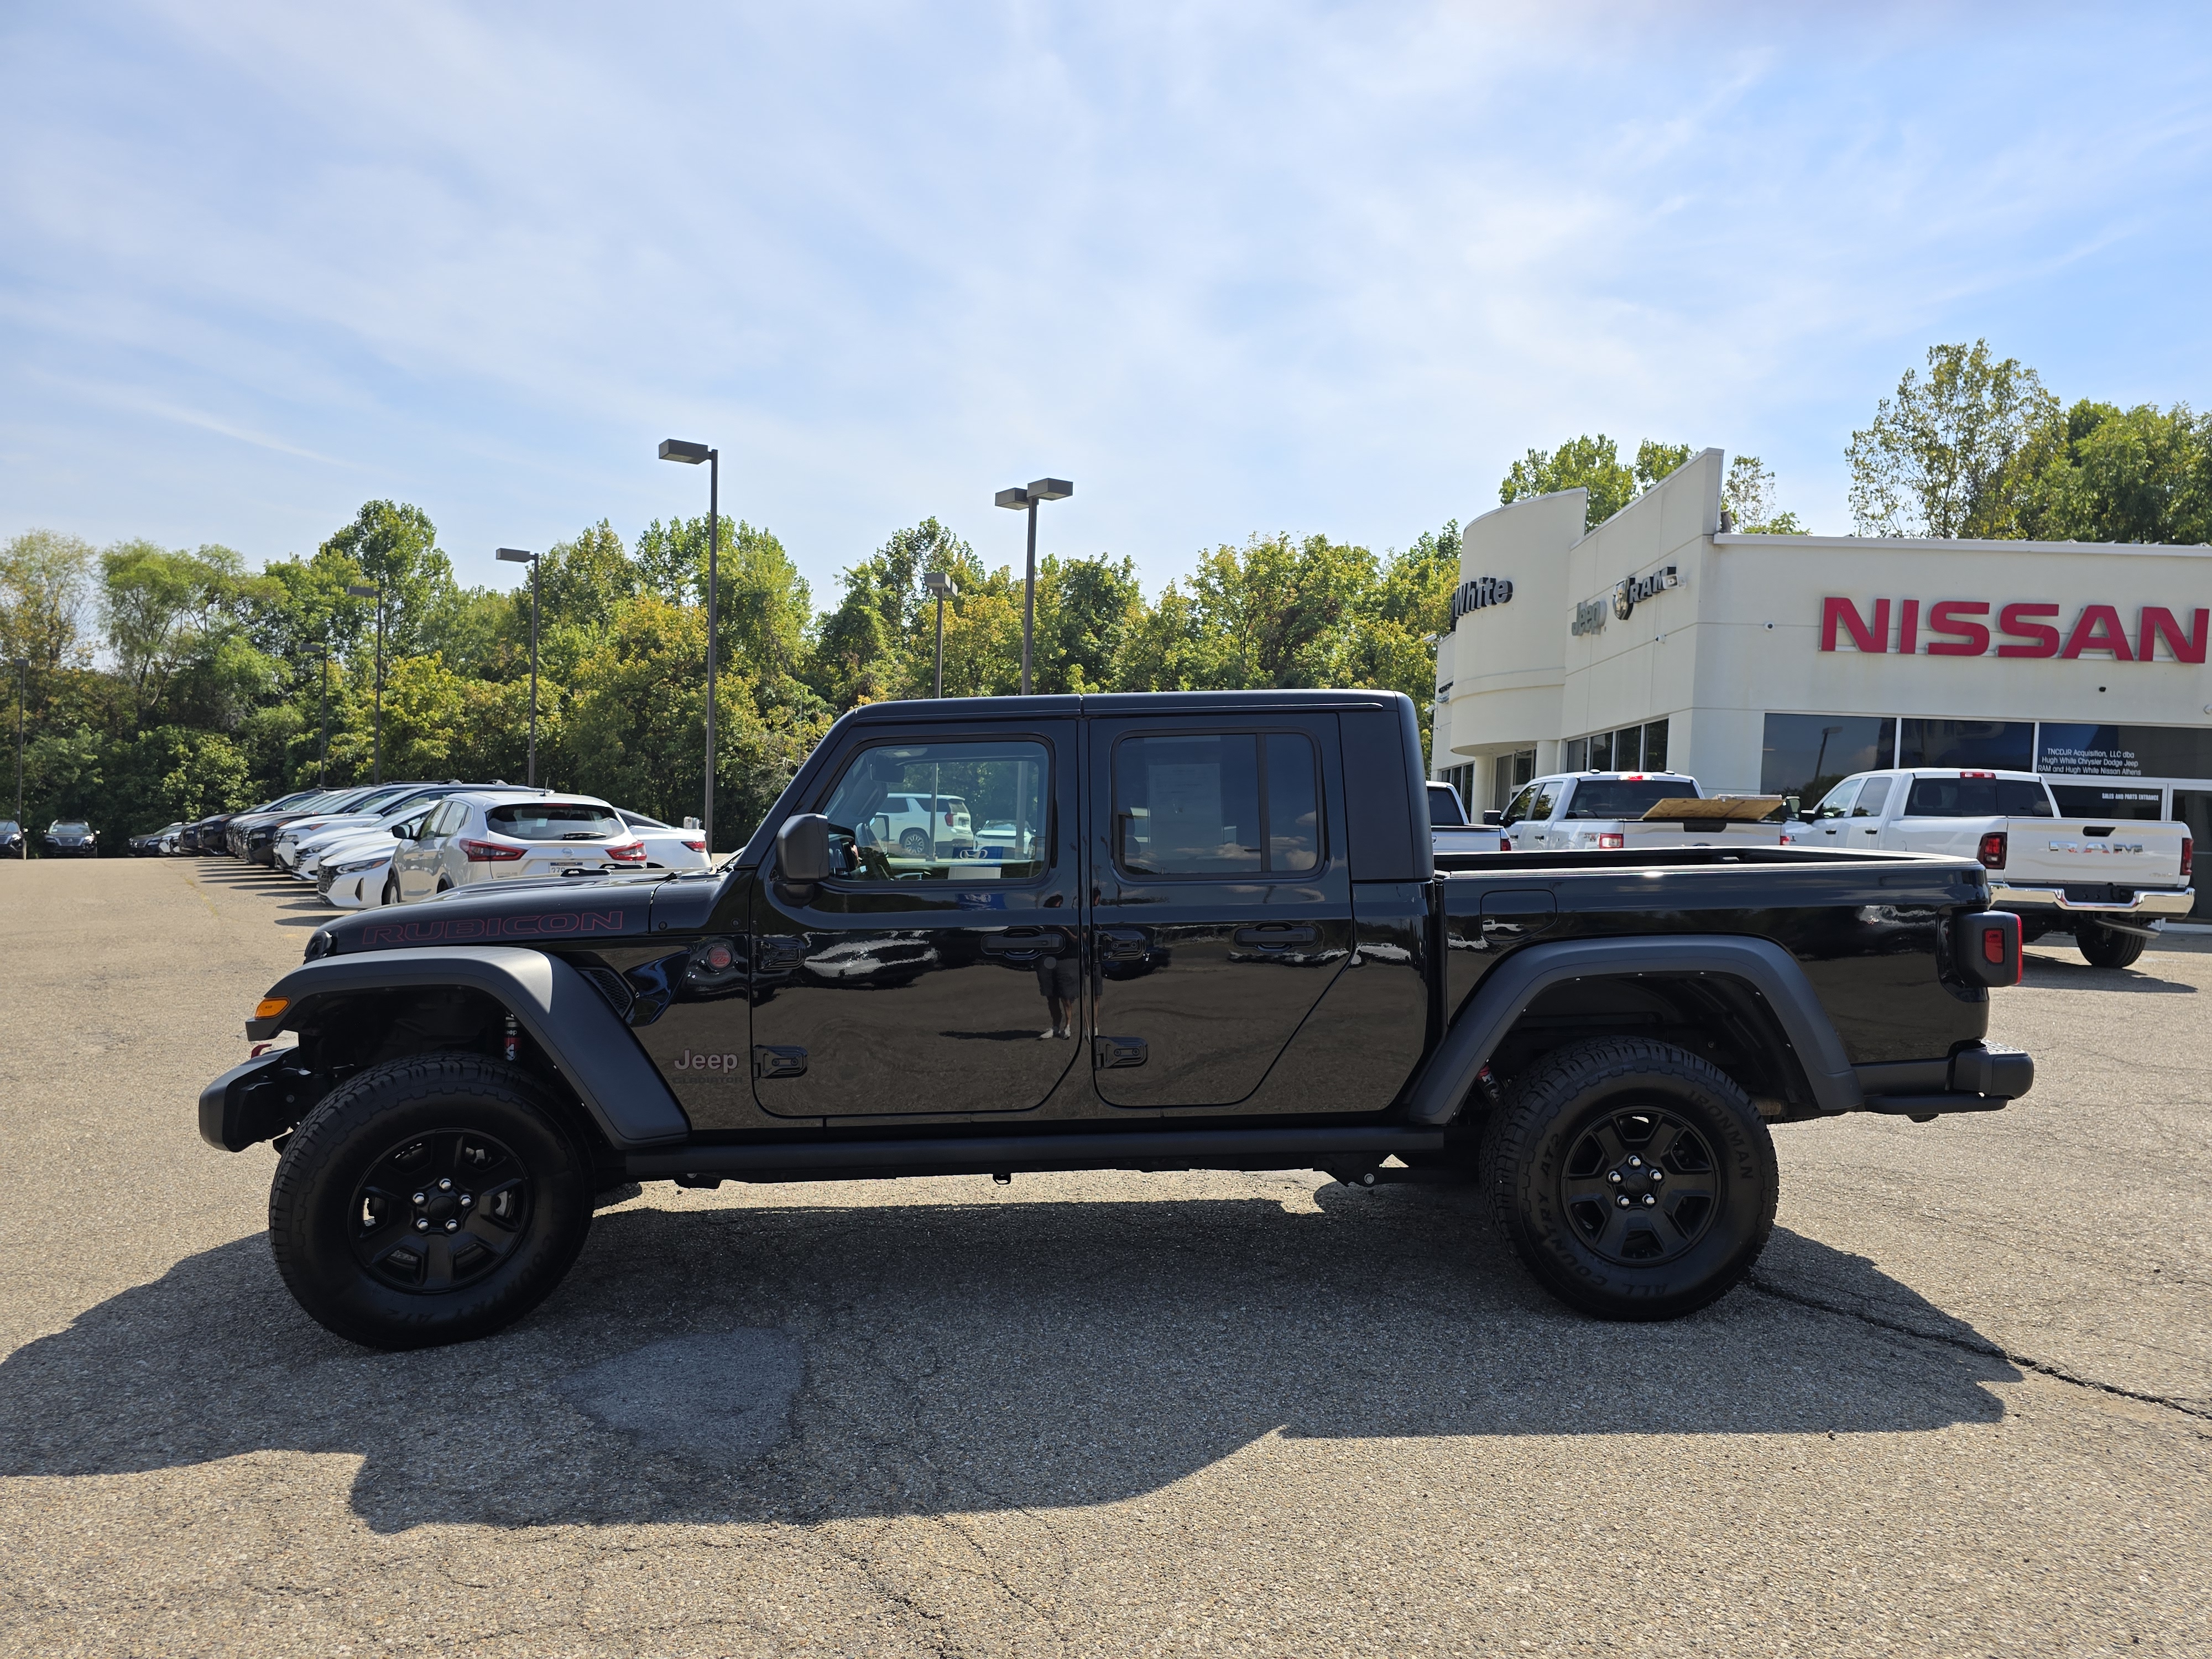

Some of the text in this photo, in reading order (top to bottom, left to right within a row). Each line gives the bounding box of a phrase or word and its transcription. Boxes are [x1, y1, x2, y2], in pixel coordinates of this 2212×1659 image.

[1454, 577, 1512, 618] White
[1572, 601, 1606, 636] Jeep
[1820, 597, 2210, 663] NISSAN
[2042, 757, 2058, 765] Hugh
[2078, 758, 2101, 766] Chrysler
[2104, 759, 2122, 768] Dodge
[2049, 841, 2144, 855] RAM
[362, 911, 623, 945] RUBICON
[674, 1049, 738, 1073] Jeep
[1687, 1089, 1754, 1180] IRONMAN
[1537, 1190, 1609, 1287] COUNTRY
